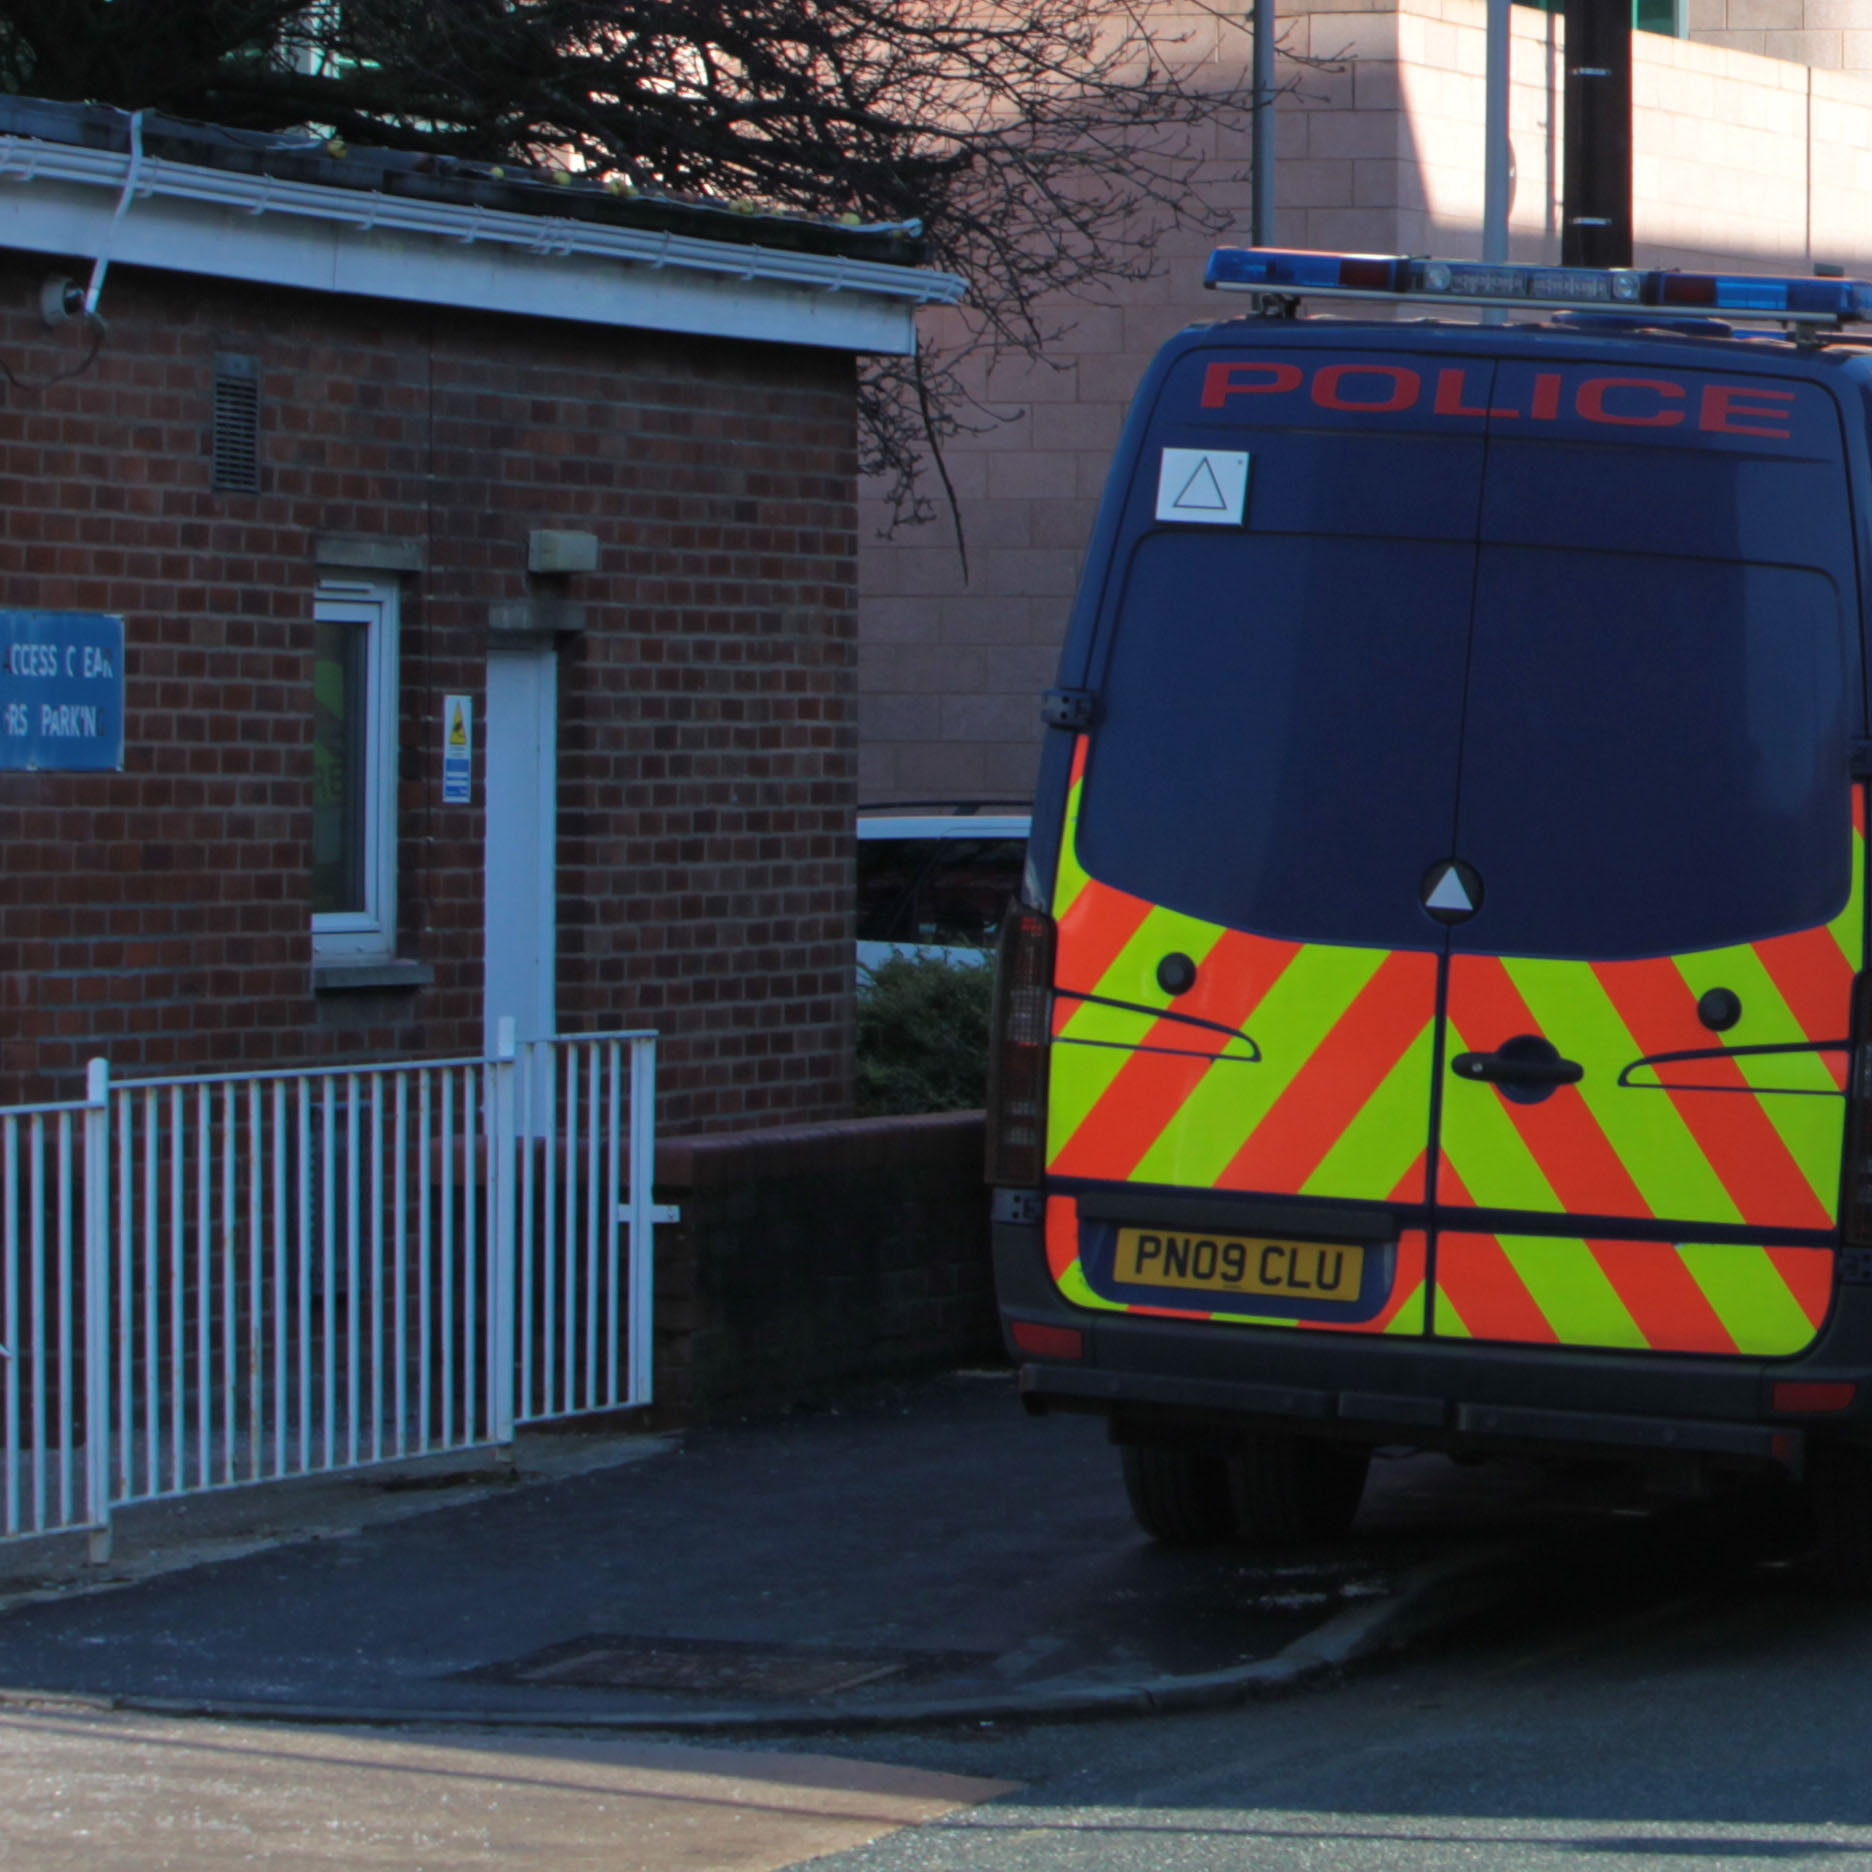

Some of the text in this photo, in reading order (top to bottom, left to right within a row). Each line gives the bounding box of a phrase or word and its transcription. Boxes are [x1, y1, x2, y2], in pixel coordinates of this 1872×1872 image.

[1200, 361, 1797, 439] POLICE
[1135, 1234, 1344, 1291] PN09 CLU
